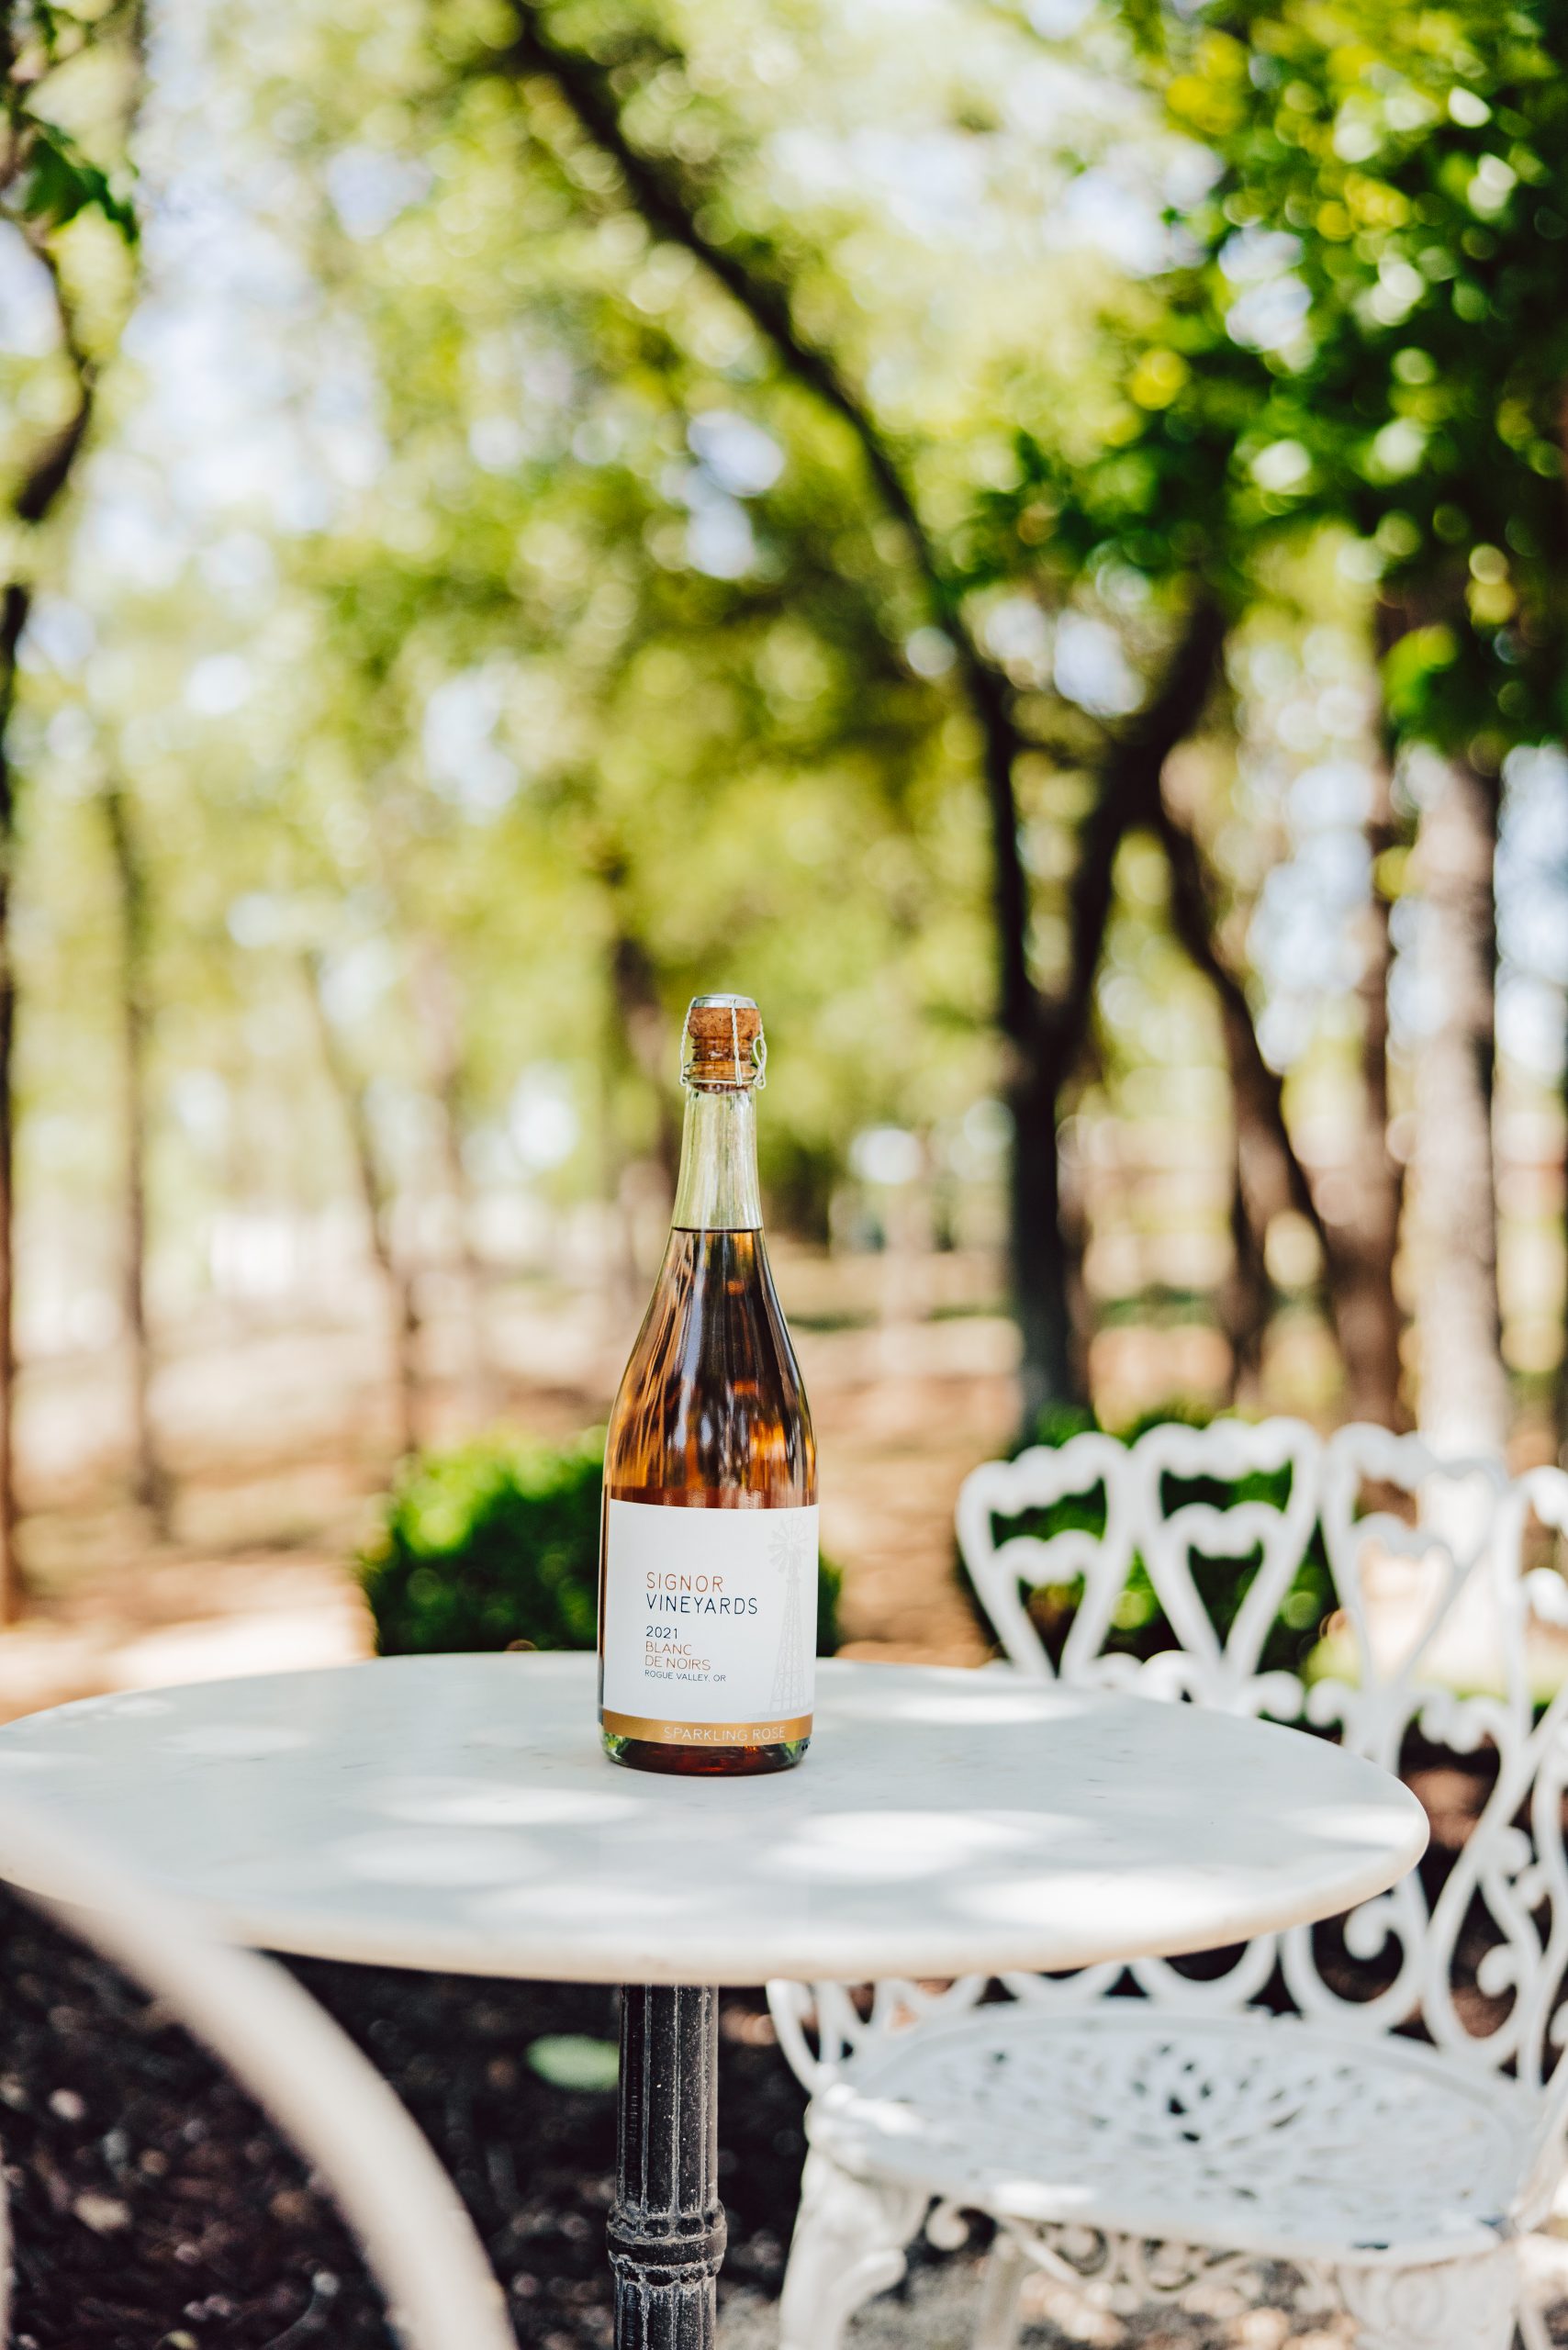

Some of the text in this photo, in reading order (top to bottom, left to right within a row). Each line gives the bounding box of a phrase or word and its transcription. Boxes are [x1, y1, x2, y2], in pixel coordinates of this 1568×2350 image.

[646, 1572, 723, 1593] SIGNOR
[646, 1593, 758, 1615] VINEYARDS
[645, 1625, 678, 1639] 2021
[645, 1640, 692, 1656] BLANC
[644, 1654, 711, 1671] DE NOIRS
[644, 1669, 674, 1680] ROGUE
[663, 1726, 748, 1741] SPARKLING
